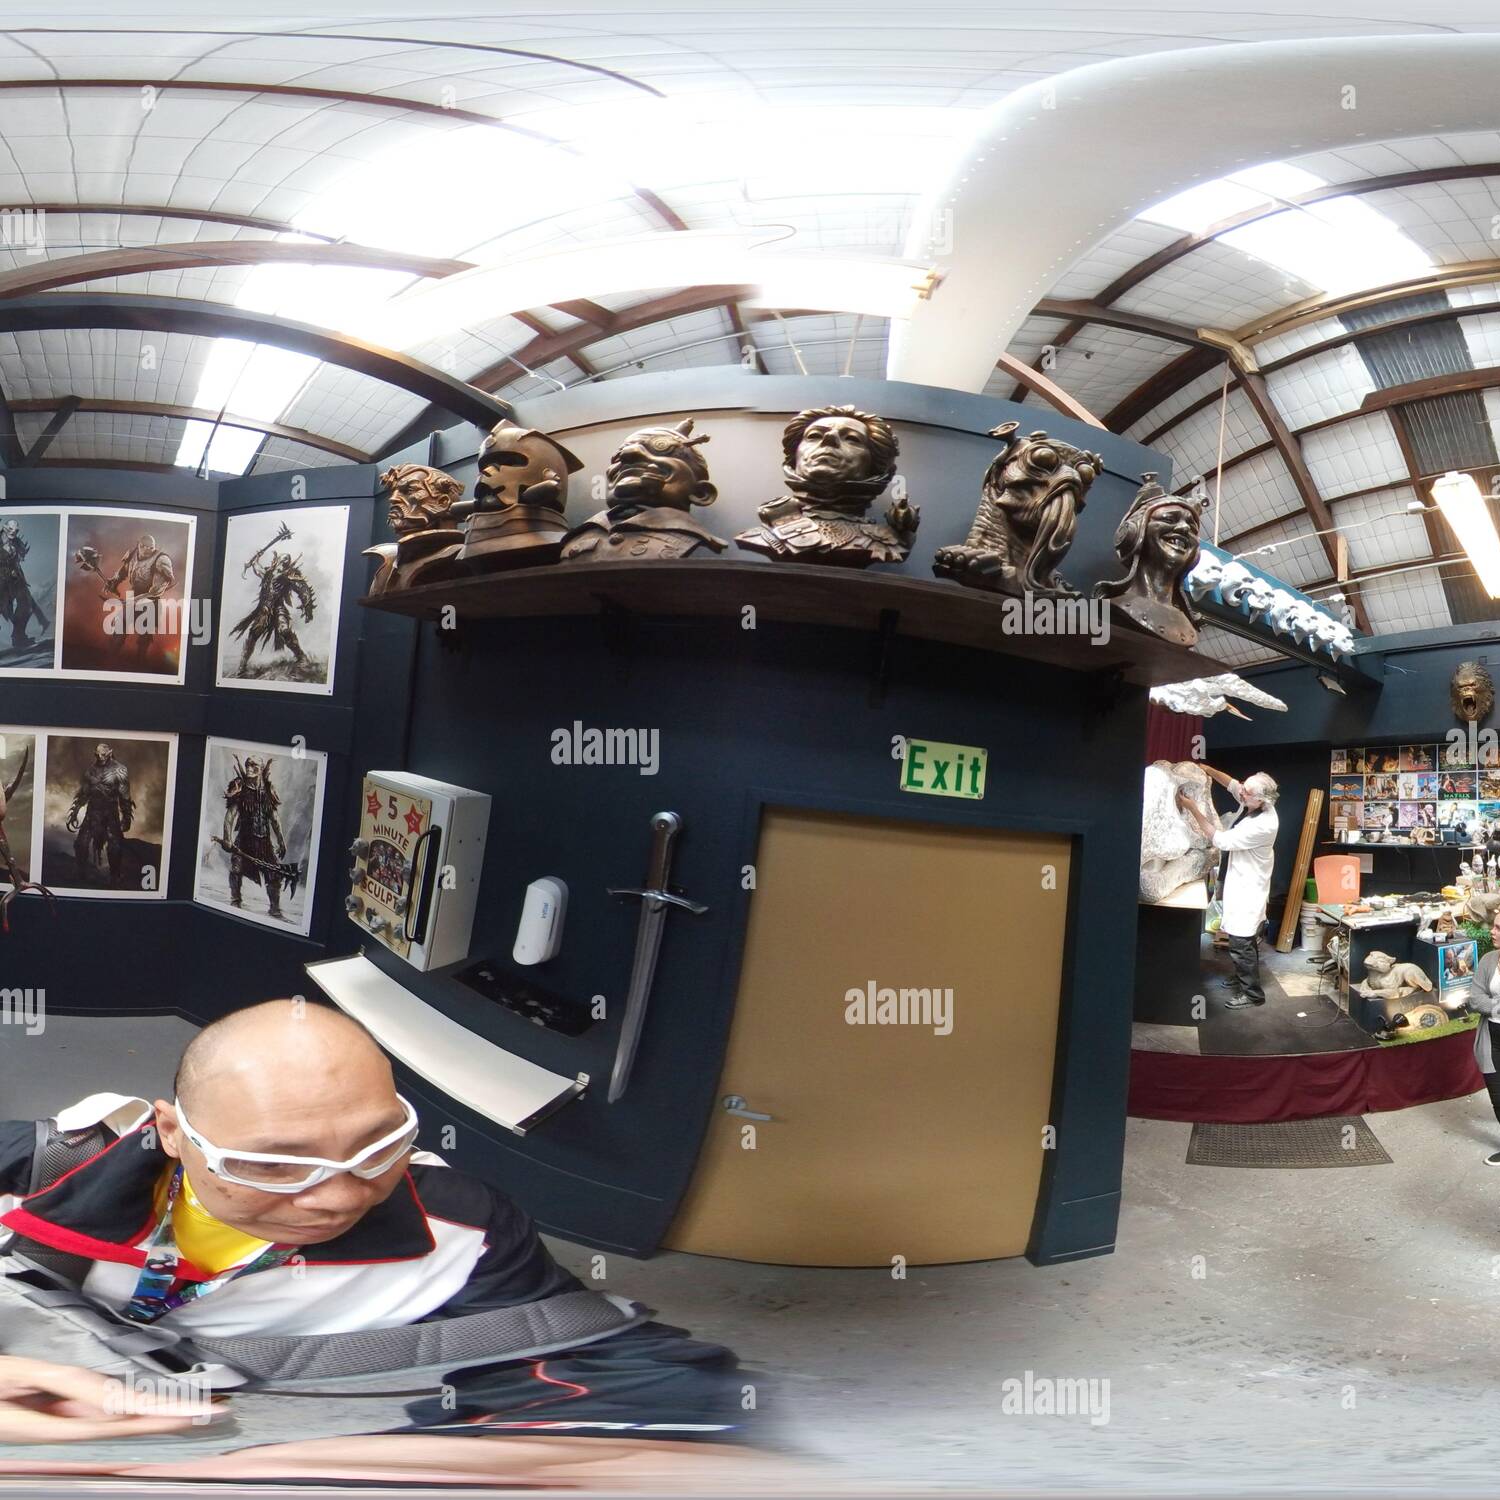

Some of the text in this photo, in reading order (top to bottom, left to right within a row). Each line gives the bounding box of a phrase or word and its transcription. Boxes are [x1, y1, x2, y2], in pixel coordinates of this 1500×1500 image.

[906, 745, 981, 794] Exit
[388, 795, 398, 820] 5
[373, 824, 409, 851] MINUTE
[362, 876, 398, 909] SCULPT
